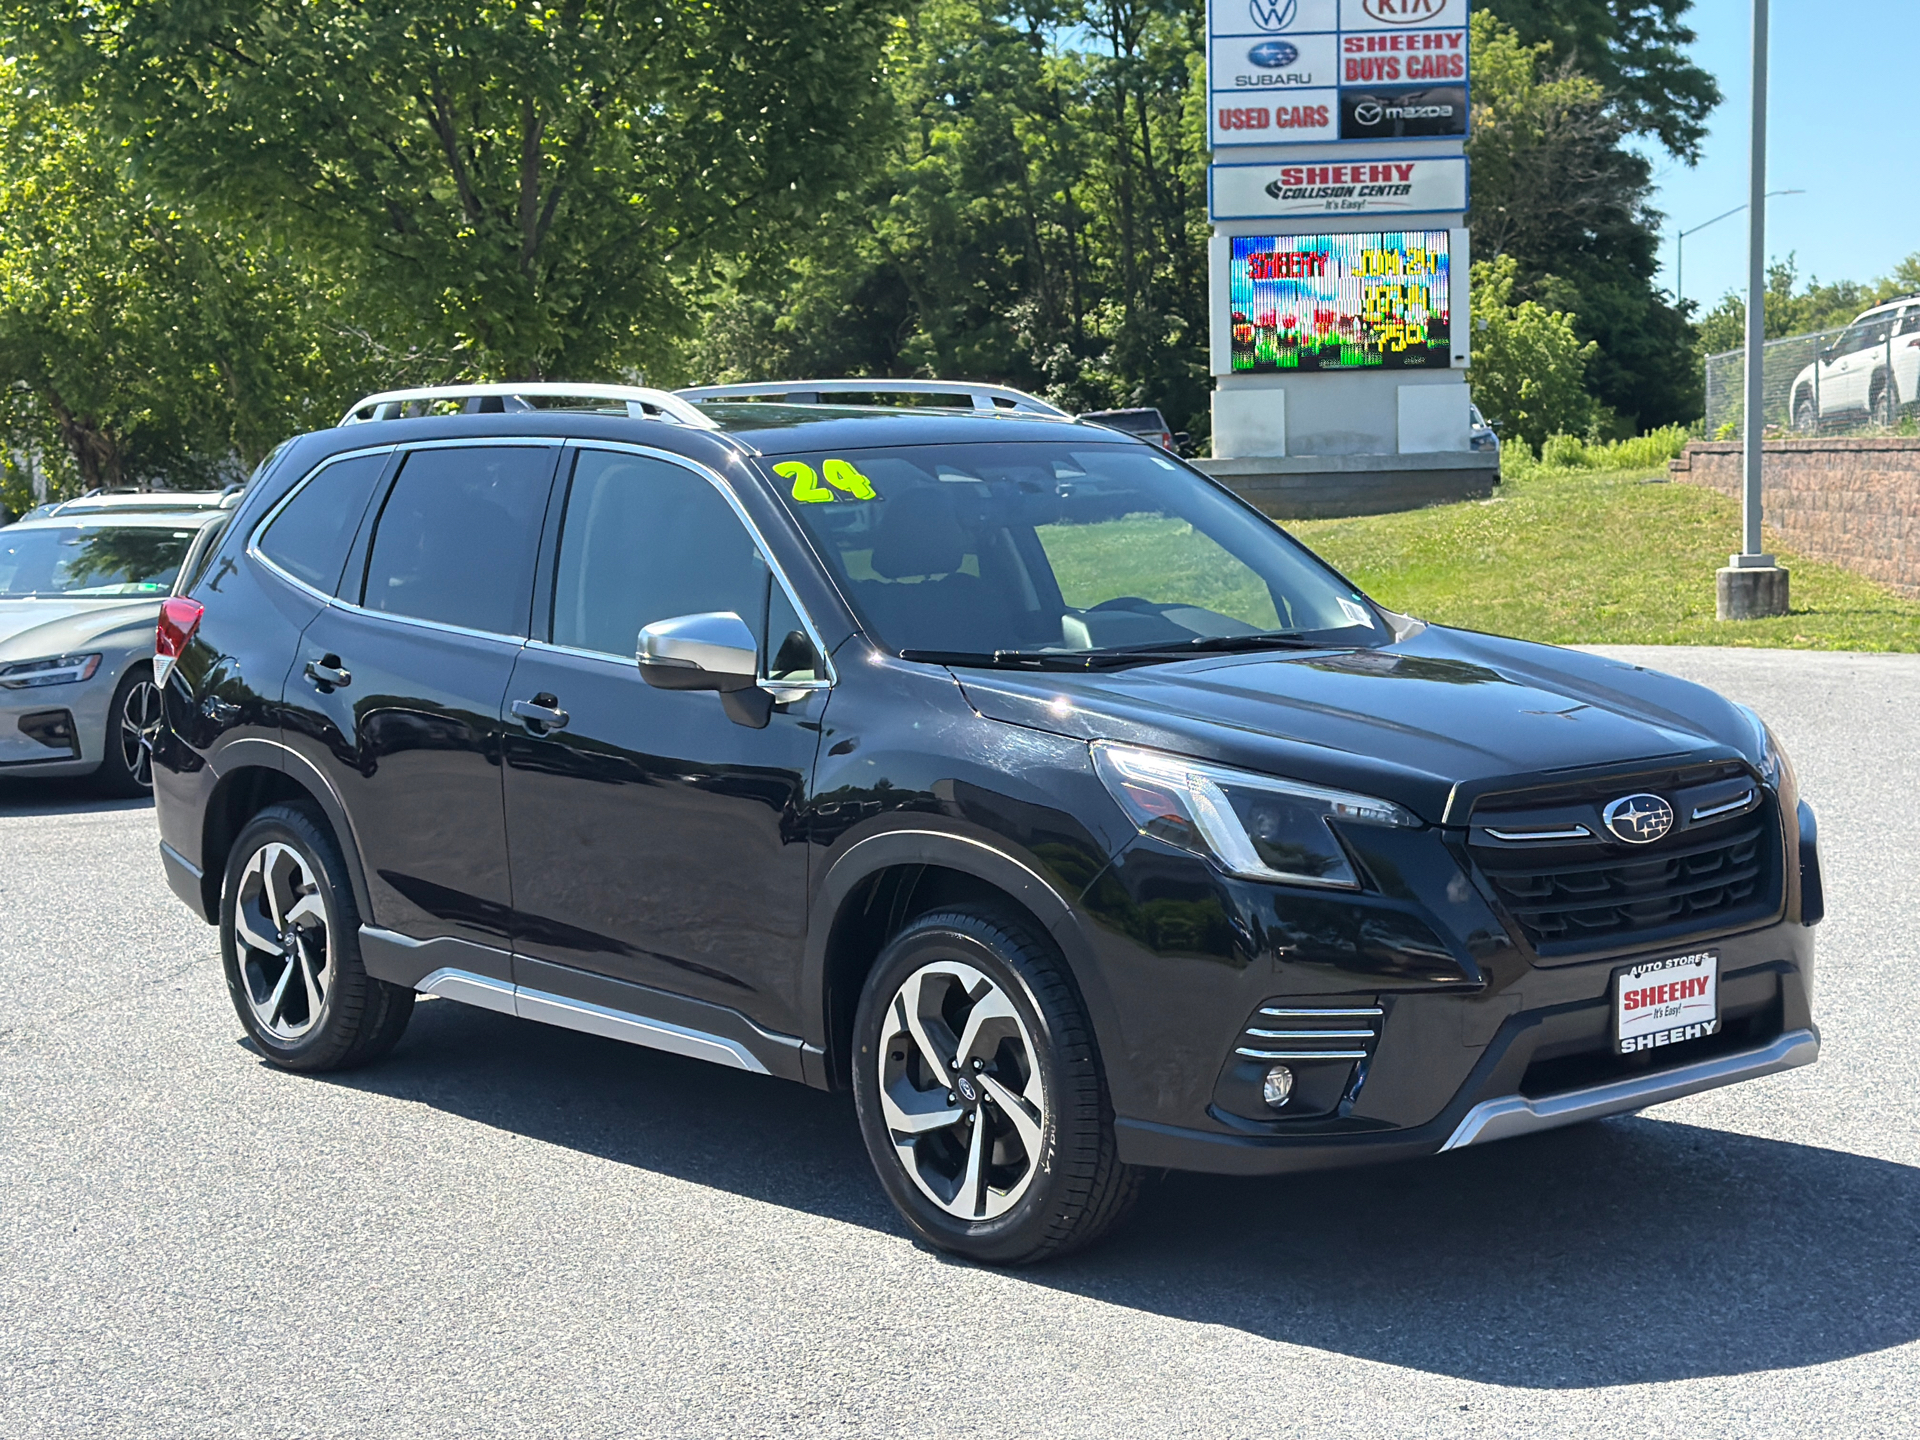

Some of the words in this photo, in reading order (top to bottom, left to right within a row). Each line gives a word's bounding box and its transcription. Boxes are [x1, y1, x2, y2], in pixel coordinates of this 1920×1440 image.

[1343, 33, 1464, 53] SHEEHY
[1345, 56, 1400, 82] BUYS
[1406, 54, 1464, 79] CARS
[1235, 73, 1312, 87] SUBARU
[1218, 107, 1270, 130] USED
[1276, 105, 1329, 128] CARS
[1385, 105, 1453, 119] mazda
[1280, 163, 1415, 186] SHEEHY
[1281, 185, 1356, 200] COLLISION
[1358, 183, 1412, 197] CENTER
[1324, 200, 1338, 210] It's
[1340, 199, 1367, 211] Easy!
[1247, 250, 1329, 279] SHEEHY
[772, 458, 877, 503] 24
[1629, 961, 1663, 976] AUTO
[1665, 952, 1709, 969] STORES
[1624, 975, 1710, 1011] SHEEHY
[1653, 1007, 1663, 1019] It's
[1664, 1003, 1682, 1018] Easy!
[1621, 1020, 1718, 1054] SHEEHY
